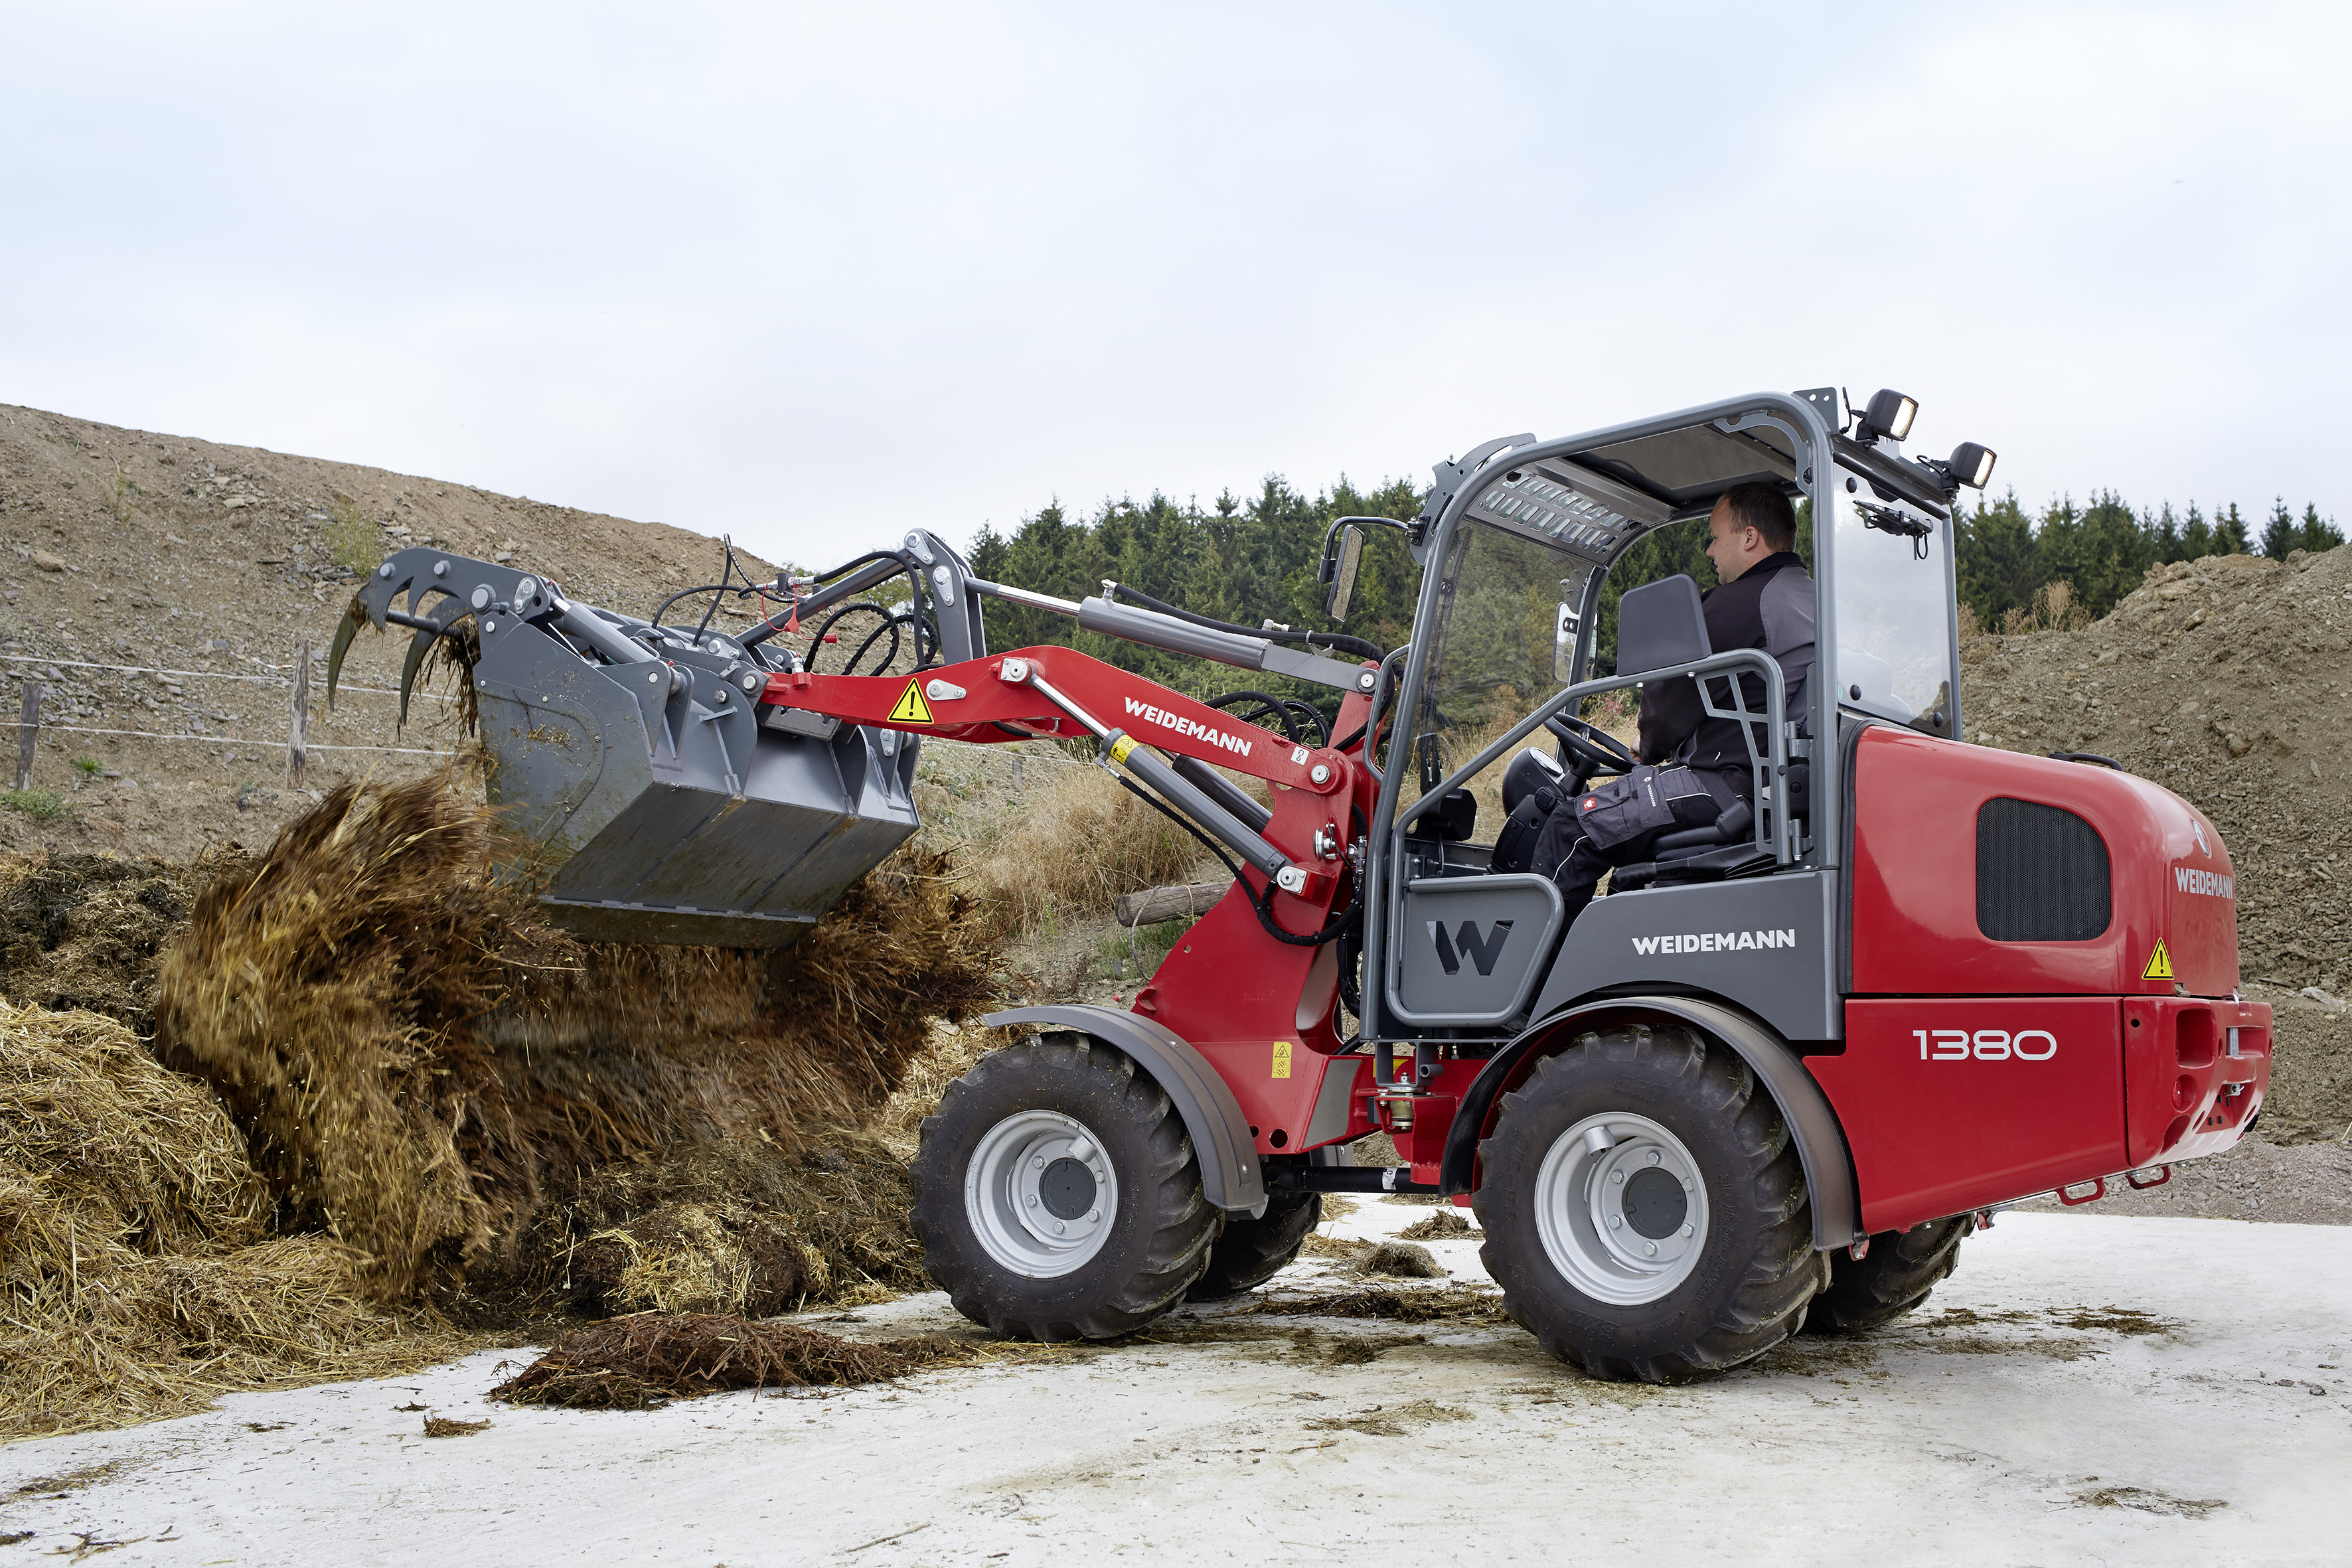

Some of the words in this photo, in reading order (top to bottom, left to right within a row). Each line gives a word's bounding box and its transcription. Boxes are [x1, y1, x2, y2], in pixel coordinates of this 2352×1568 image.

[1125, 696, 1253, 757] WEIDEMANN
[2175, 867, 2233, 900] WEIDEMANN
[1425, 920, 1514, 976] W
[1632, 929, 1796, 955] WEIDEMANN
[1913, 1030, 2057, 1061] 1380
